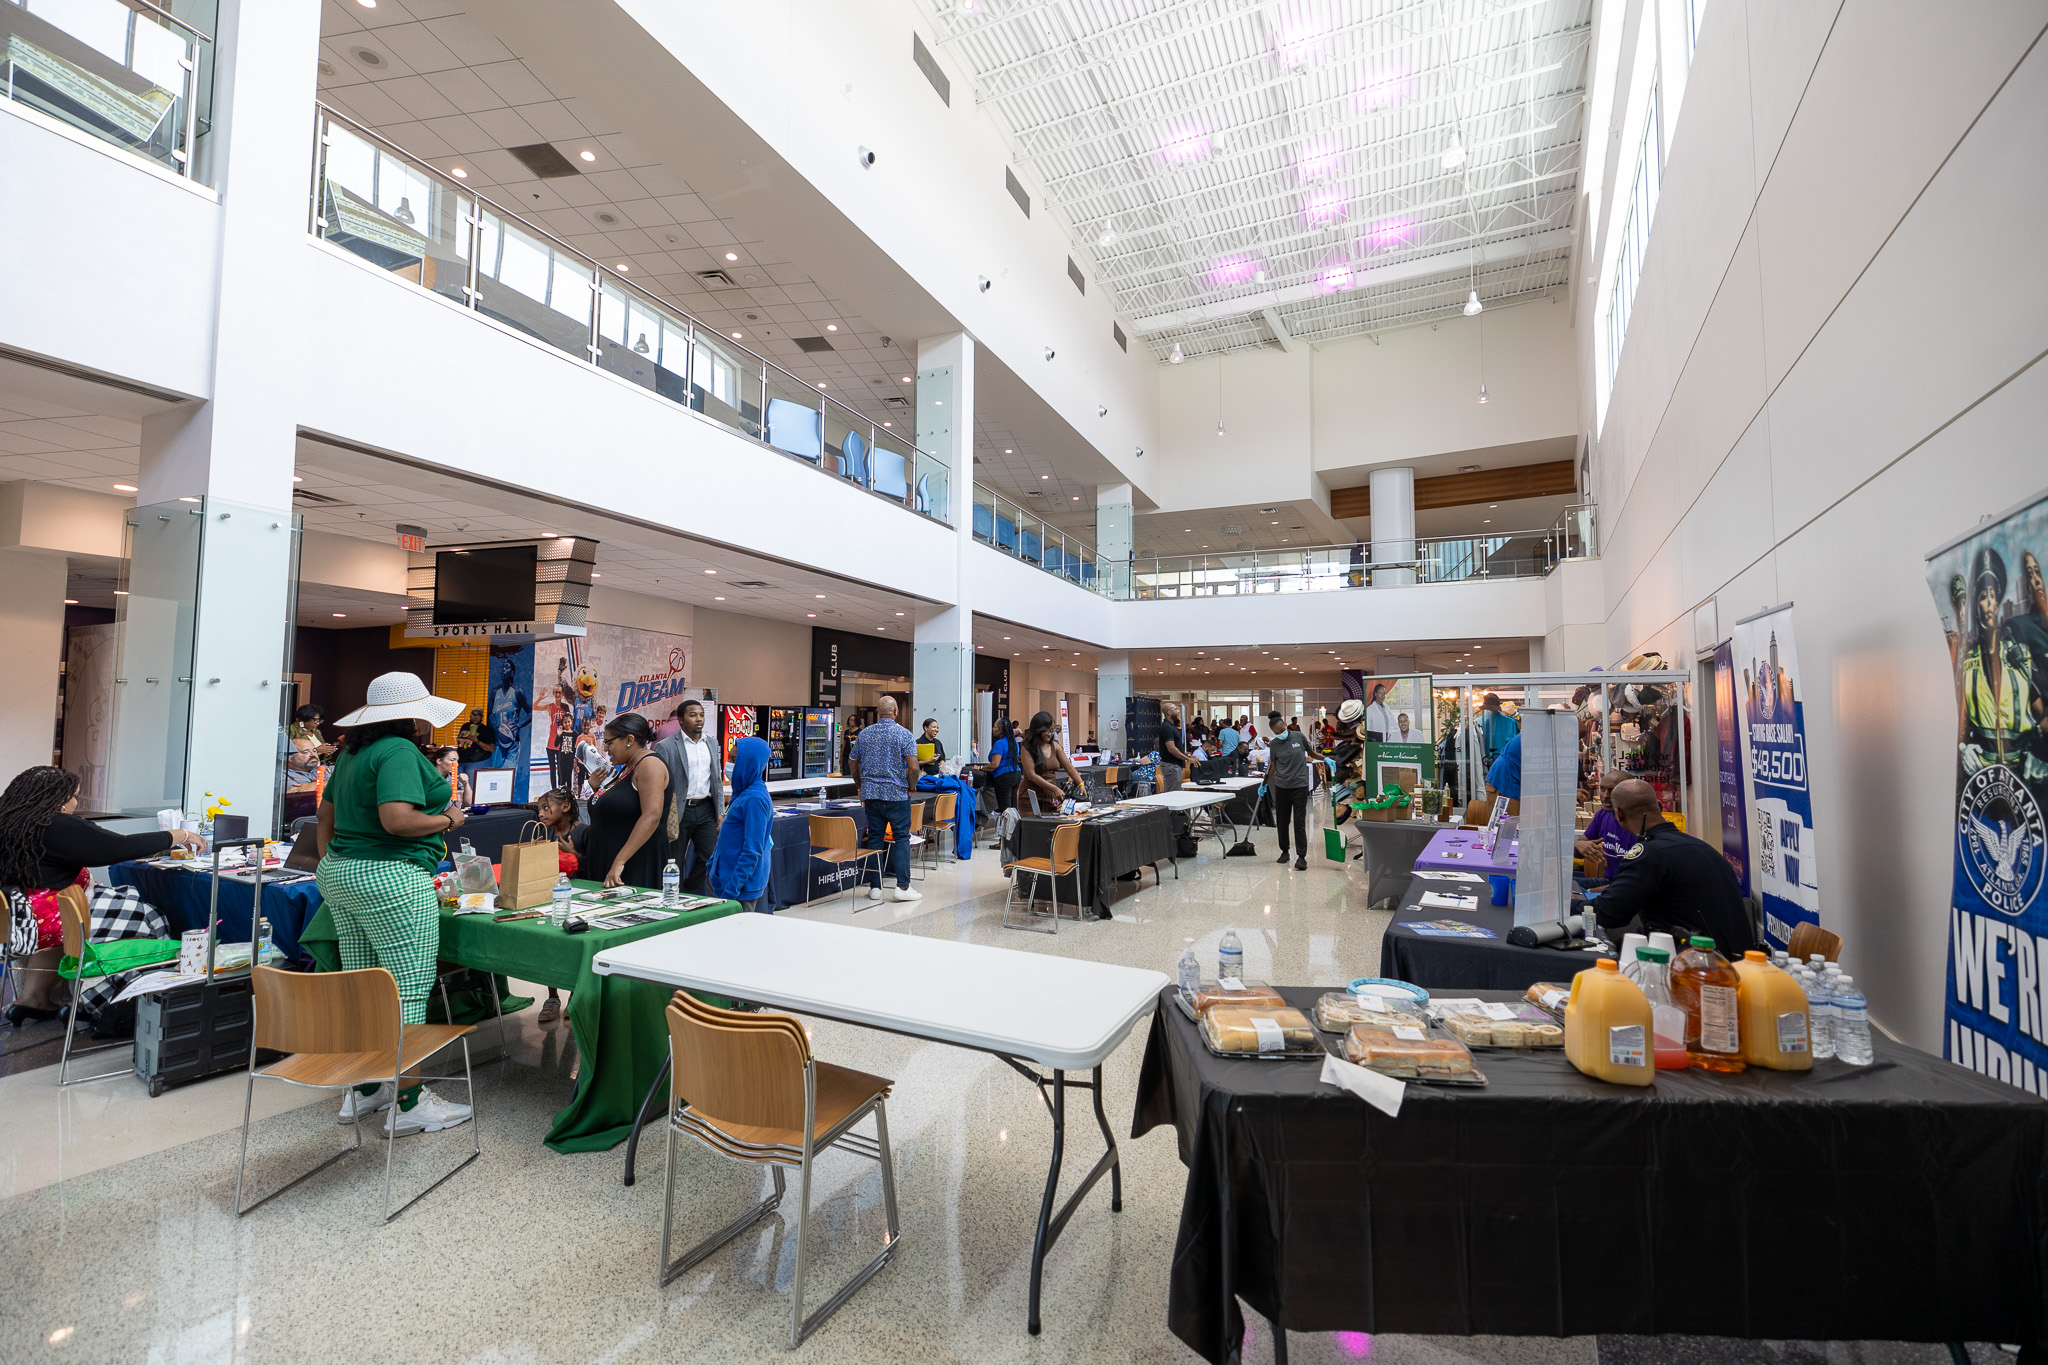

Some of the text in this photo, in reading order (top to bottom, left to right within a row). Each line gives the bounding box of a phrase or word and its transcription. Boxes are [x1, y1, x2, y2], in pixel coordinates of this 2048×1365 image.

[402, 534, 423, 551] EXIT
[434, 623, 530, 637] SPORTS HALL
[830, 644, 838, 677] CLUB
[638, 672, 668, 684] ATLANTA
[615, 677, 686, 715] DREAM
[1777, 723, 1794, 744] SALARY
[1619, 751, 1671, 761] JagWear
[1619, 761, 1672, 772] Fashions
[1752, 745, 1804, 781] $48,500
[1633, 773, 1670, 784] pparel
[1960, 768, 2043, 847] CITY OF ATLANTA
[1976, 785, 2019, 815] RESURGENS
[1780, 818, 1800, 852] APPLY
[1970, 827, 1980, 855] 1847
[2020, 838, 2030, 866] 1865
[818, 872, 836, 885] HIRE
[1784, 853, 1800, 888] NOW
[1980, 863, 2015, 892] ATLANTA
[1982, 882, 2025, 912] POLICE
